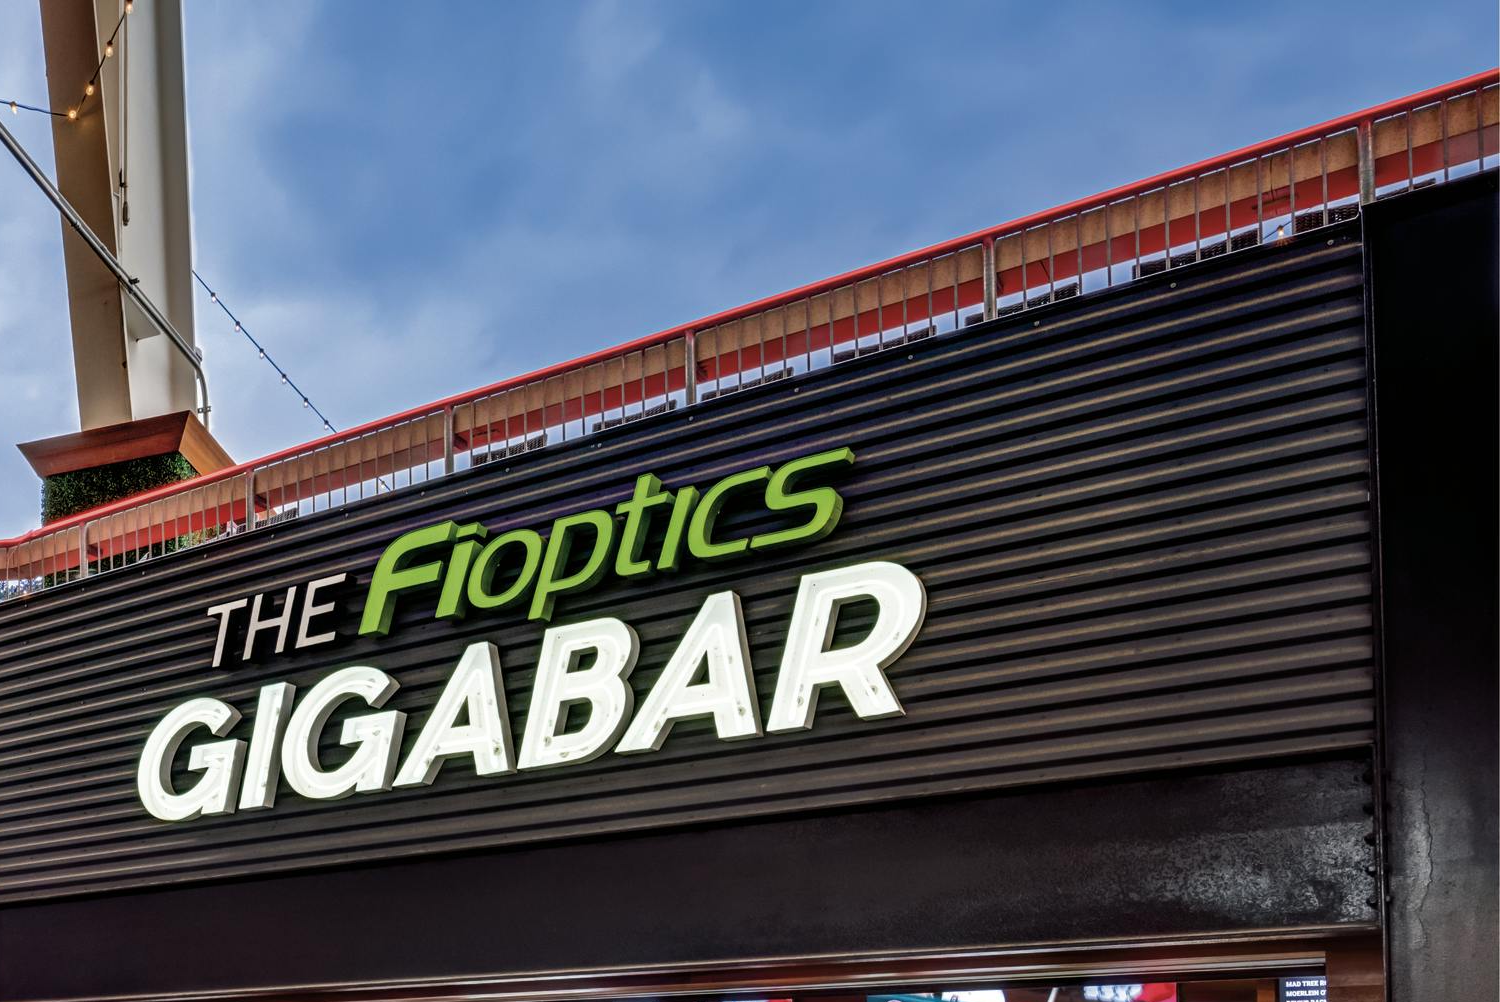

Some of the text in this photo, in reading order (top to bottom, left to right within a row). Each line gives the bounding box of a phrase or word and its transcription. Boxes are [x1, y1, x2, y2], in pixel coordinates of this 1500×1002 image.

[207, 447, 856, 667] THE Fioptics
[137, 561, 927, 822] GIGABAR
